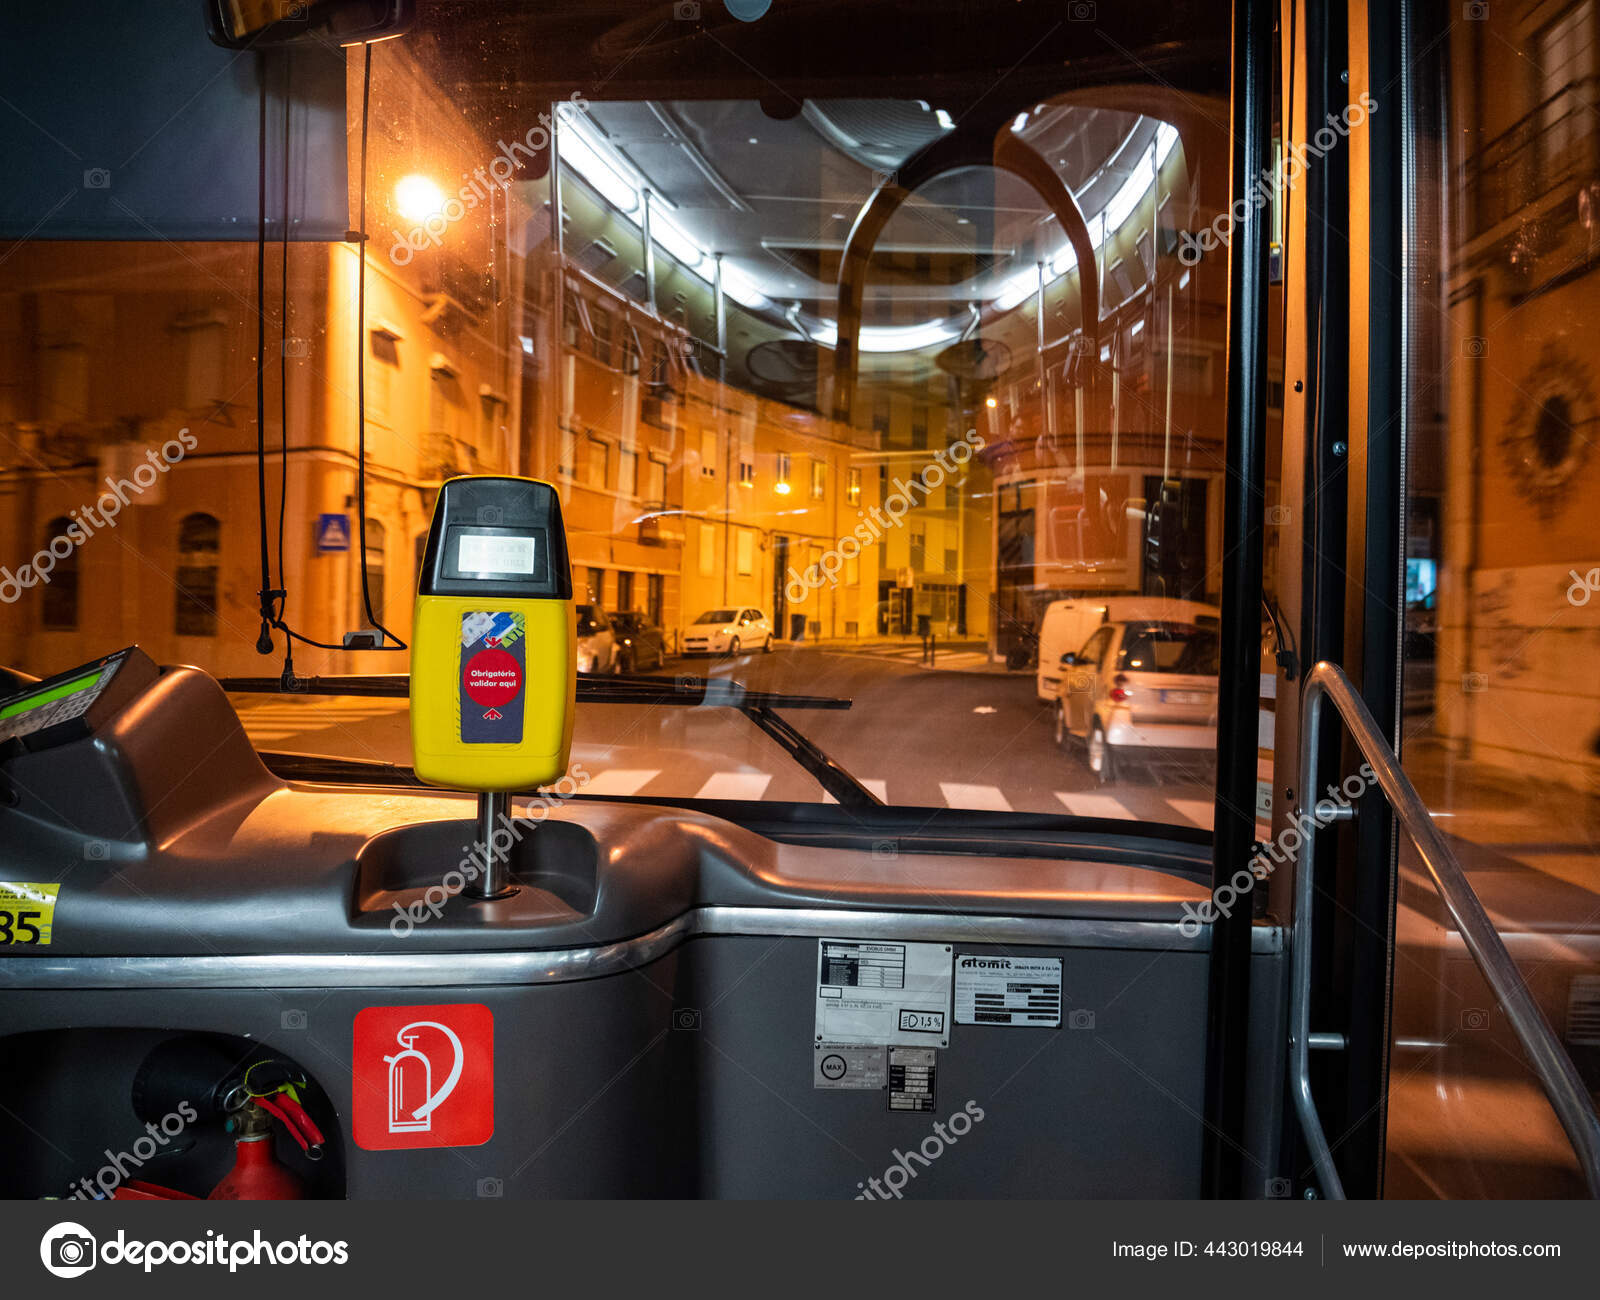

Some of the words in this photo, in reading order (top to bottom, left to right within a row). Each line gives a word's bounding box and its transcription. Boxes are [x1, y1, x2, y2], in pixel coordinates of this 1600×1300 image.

[471, 670, 516, 678] Obrigatório
[499, 680, 517, 688] aqui
[961, 958, 1012, 970] Atomic
[921, 1016, 932, 1027] 1,5
[933, 1017, 941, 1028] %
